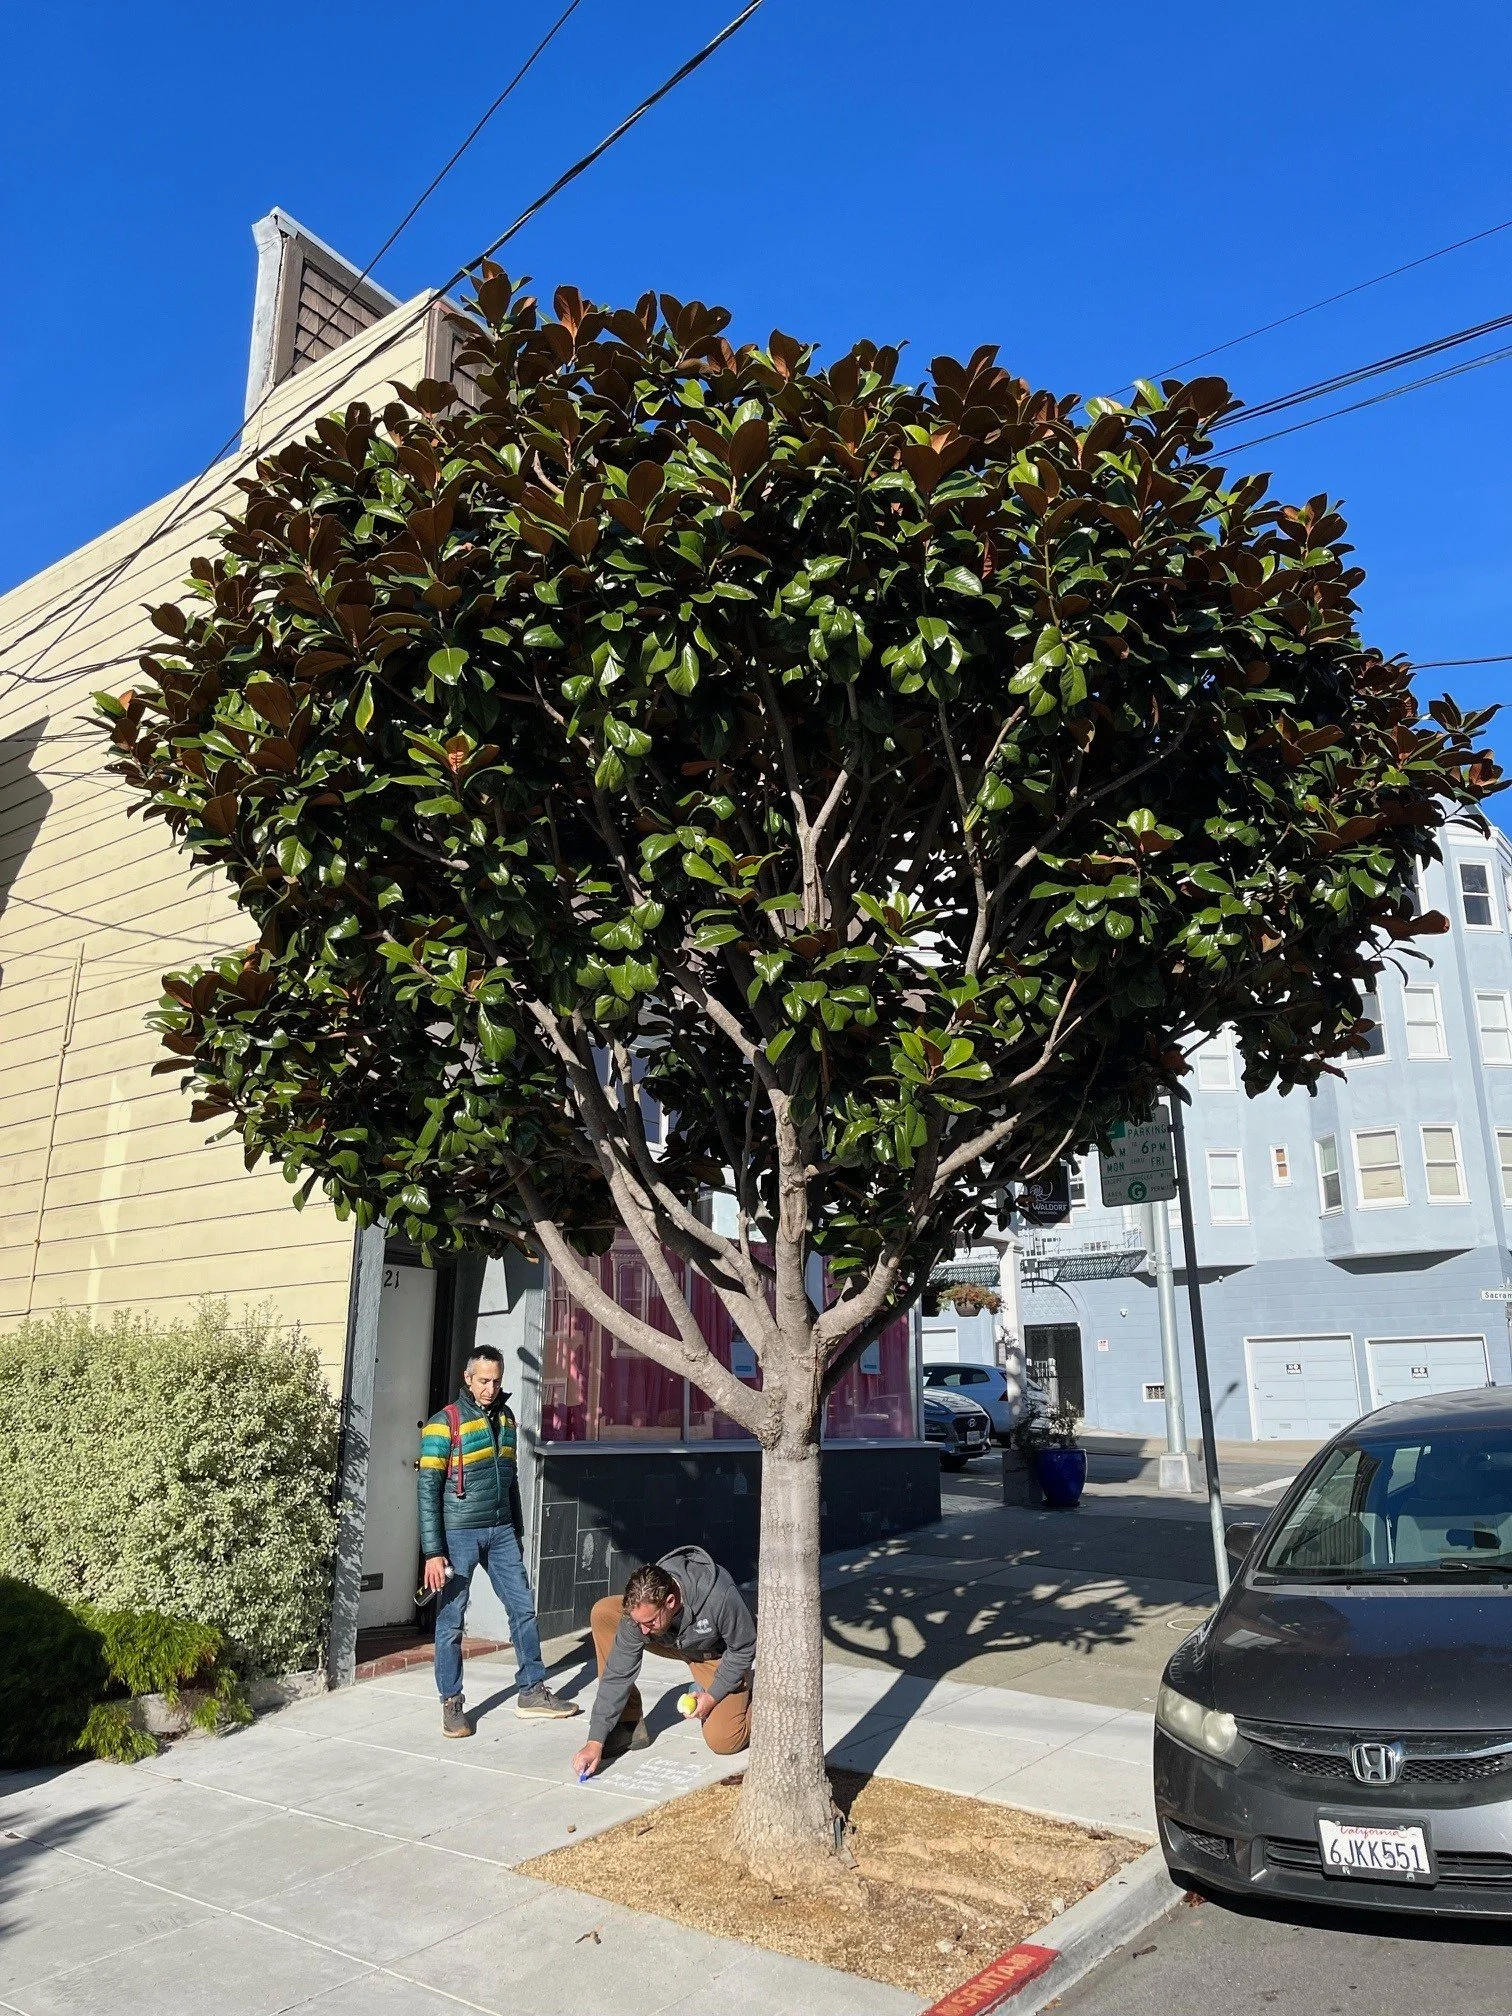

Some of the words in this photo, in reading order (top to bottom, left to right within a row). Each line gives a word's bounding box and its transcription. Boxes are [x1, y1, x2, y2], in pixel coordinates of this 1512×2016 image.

[1128, 1124, 1167, 1138] PARKING
[1106, 1162, 1125, 1173] MON
[1151, 1156, 1165, 1167] FRI
[1131, 1184, 1144, 1199] G
[1032, 1202, 1068, 1211] WALDORF
[384, 1270, 400, 1290] 21
[1340, 1826, 1406, 1839] California
[1330, 1838, 1425, 1872] 6JKK551
